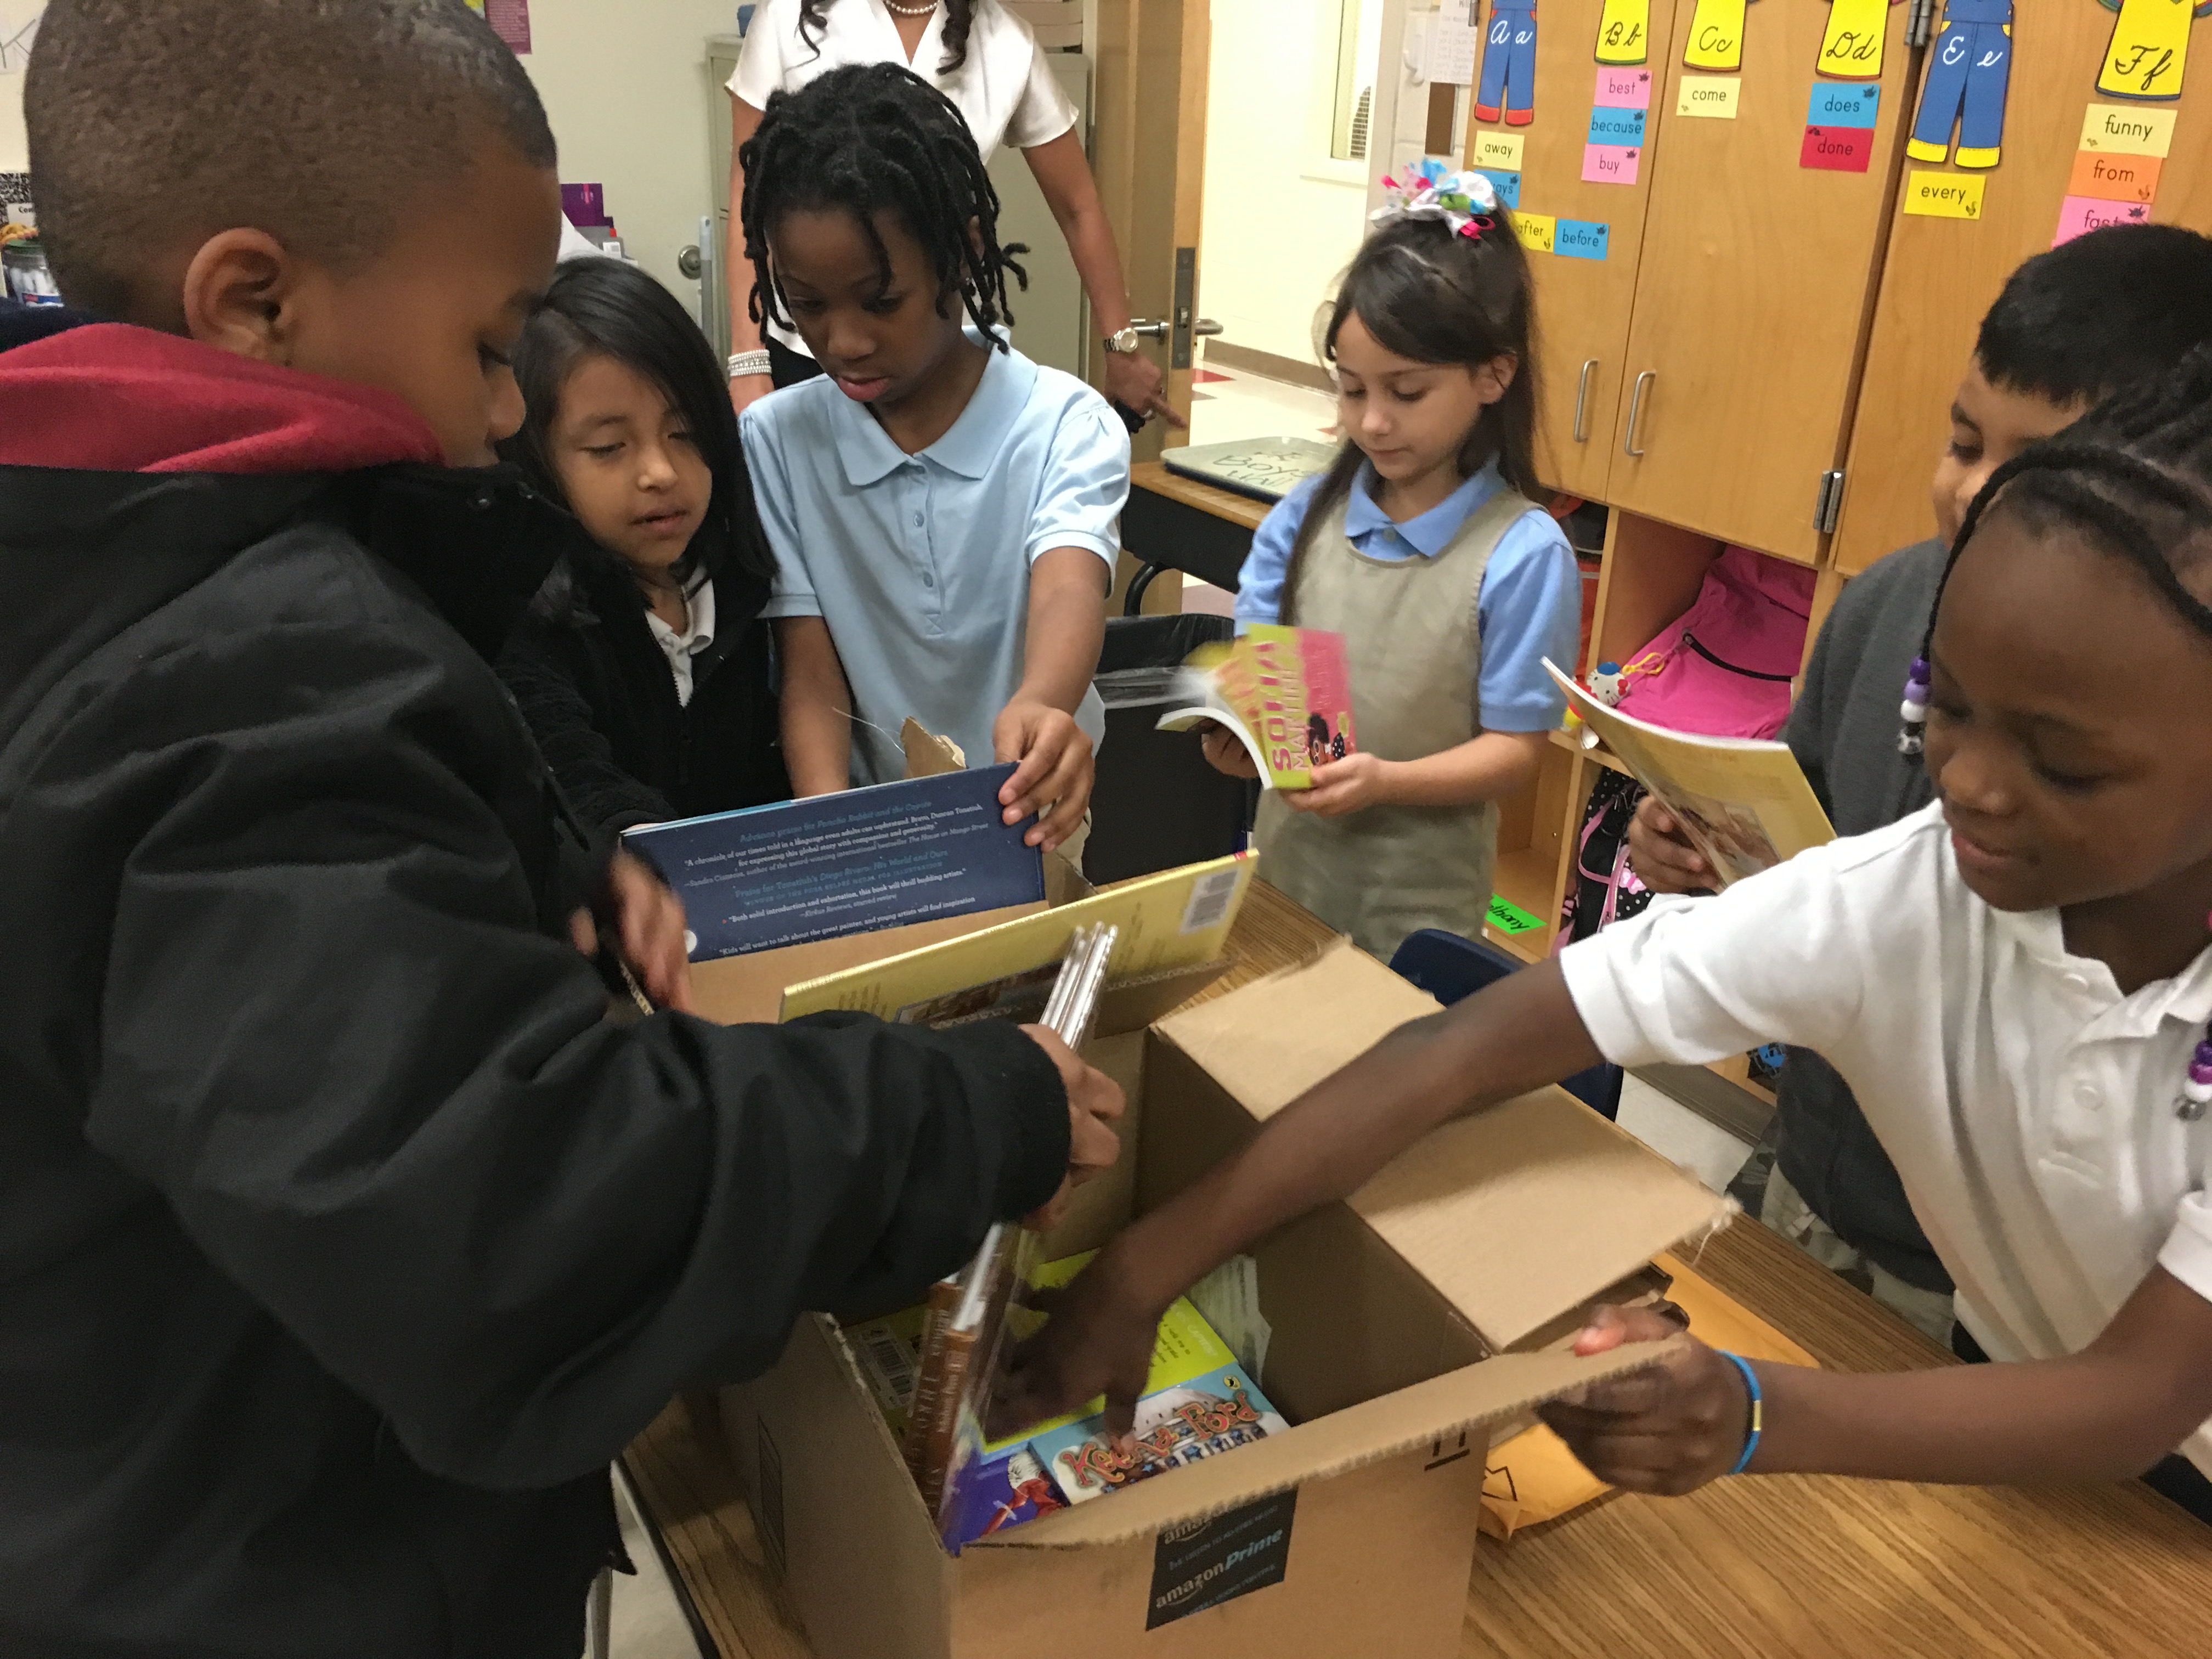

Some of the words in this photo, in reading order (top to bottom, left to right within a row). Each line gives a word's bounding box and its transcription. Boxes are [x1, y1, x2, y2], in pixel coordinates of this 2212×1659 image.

[1605, 21, 1643, 47] Bb
[1699, 26, 1733, 53] Cc
[1826, 31, 1877, 60] Dd
[2115, 45, 2173, 91] Ff
[1609, 81, 1635, 95] best
[1691, 89, 1726, 103] come
[1824, 97, 1860, 112] does
[1591, 116, 1642, 134] because
[2105, 114, 2153, 140] funny
[1485, 143, 1513, 159] away
[1817, 141, 1853, 156] done
[1599, 157, 1620, 174] buy
[2093, 163, 2134, 183] from
[1493, 182, 1513, 198] ays
[1921, 184, 1967, 204] every
[1516, 219, 1543, 236] after
[2084, 209, 2120, 228] fast
[1562, 230, 1599, 247] before
[777, 826, 803, 838] praise
[726, 850, 735, 859] of
[747, 847, 766, 855] times
[766, 842, 781, 851] told
[841, 827, 861, 837] adults
[749, 853, 785, 865] expressing
[799, 844, 820, 856] global
[820, 843, 837, 851] story
[837, 839, 852, 847] with
[889, 828, 902, 837] and
[762, 884, 775, 893] for
[913, 851, 928, 862] and
[769, 863, 777, 871] of
[748, 909, 766, 919] solid
[766, 902, 807, 915] introduction
[807, 898, 820, 907] and
[871, 884, 888, 894] book
[888, 881, 900, 890] will
[900, 878, 916, 888] thrill
[738, 943, 752, 951] will
[752, 940, 768, 949] want
[777, 934, 790, 943] talk
[791, 932, 809, 940] about
[821, 925, 838, 935] great
[864, 916, 876, 924] and
[877, 913, 896, 923] young
[897, 909, 917, 918] artists
[917, 905, 929, 913] will
[1175, 1389, 1262, 1441] Ford
